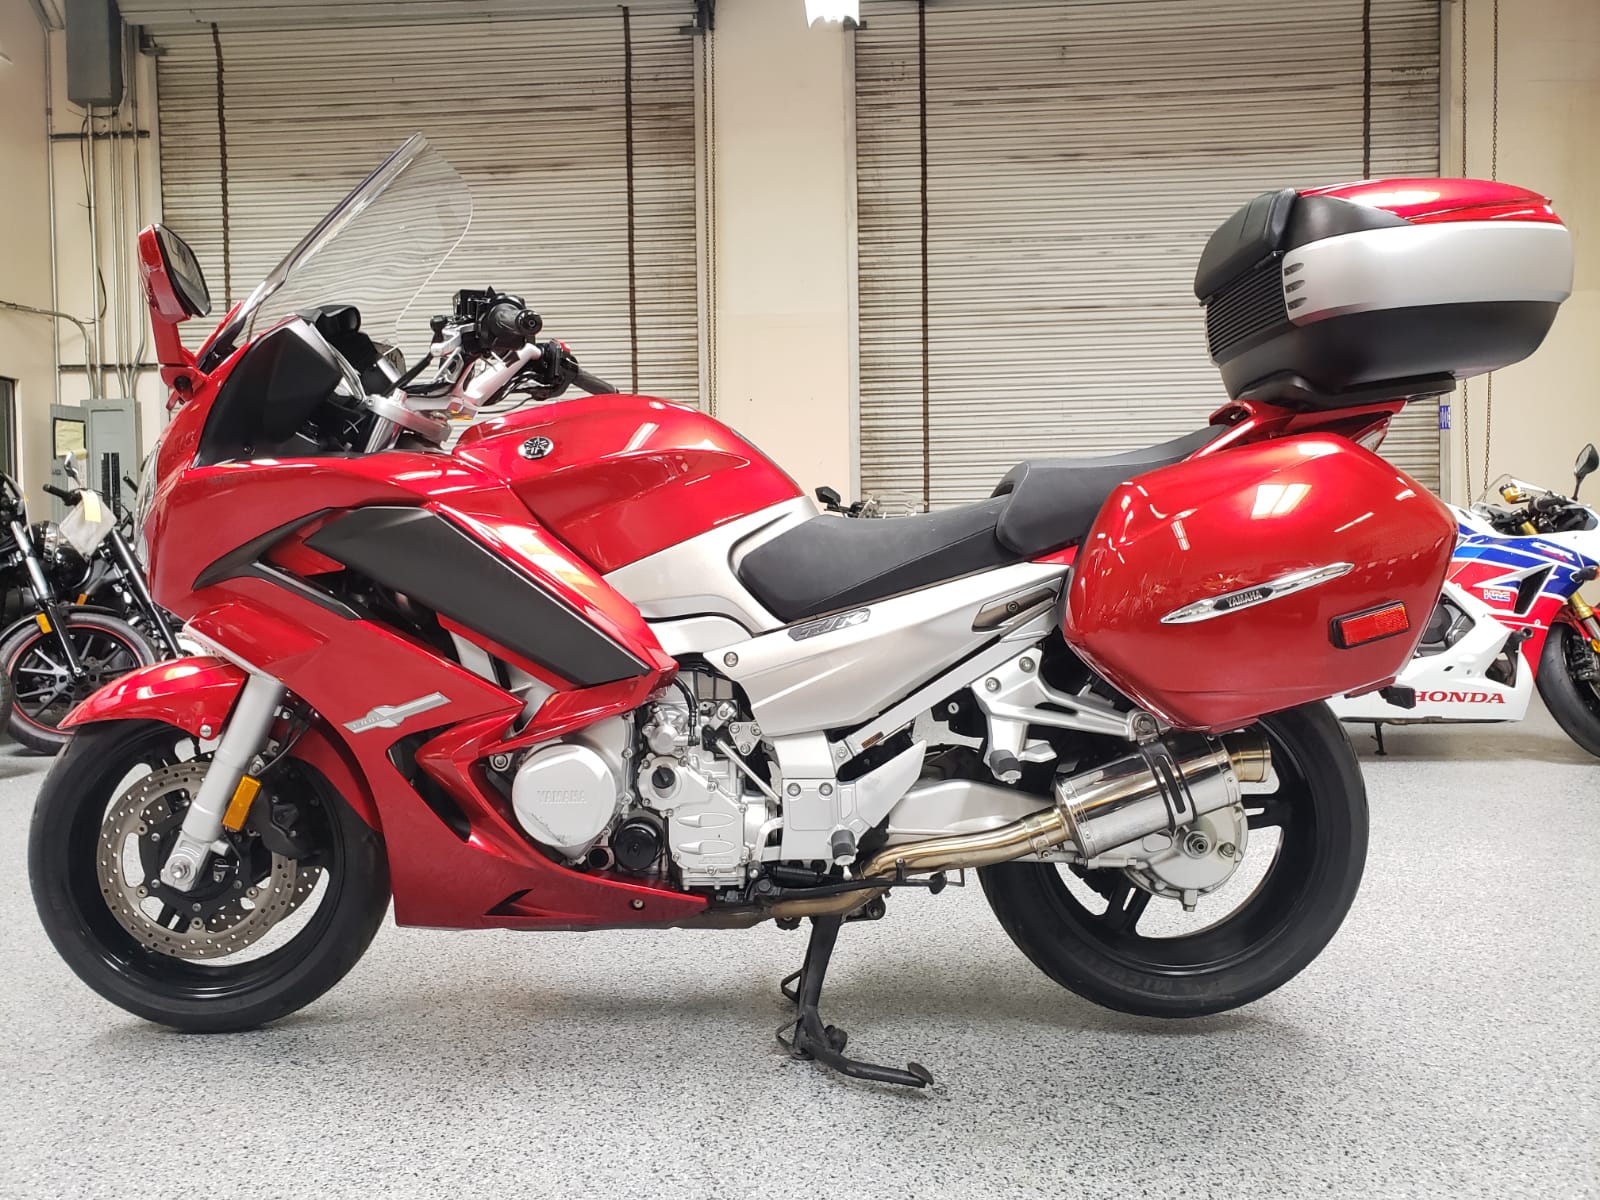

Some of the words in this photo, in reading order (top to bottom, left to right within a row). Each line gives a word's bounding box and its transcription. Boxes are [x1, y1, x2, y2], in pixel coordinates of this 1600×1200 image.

[1226, 590, 1263, 607] YAMAHA
[1415, 691, 1505, 704] HONDA
[537, 790, 586, 804] YAMAHA
